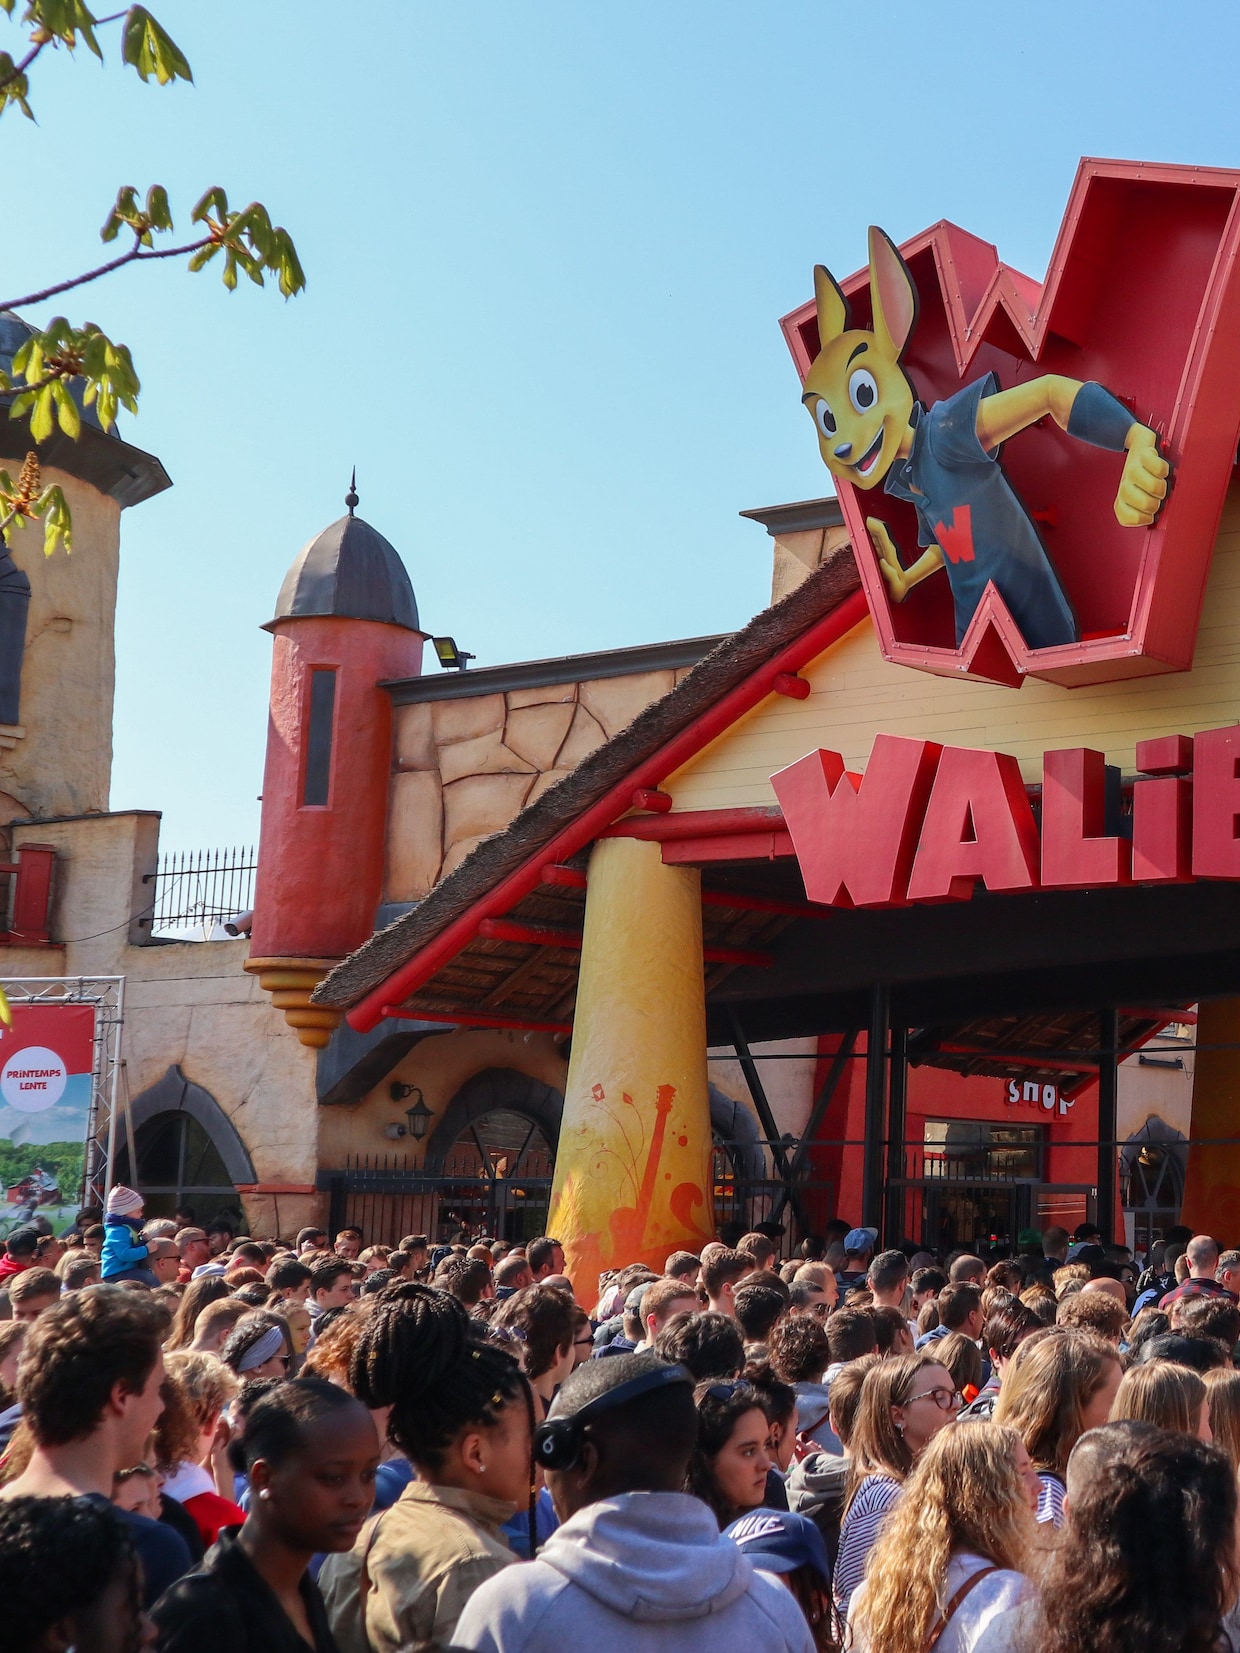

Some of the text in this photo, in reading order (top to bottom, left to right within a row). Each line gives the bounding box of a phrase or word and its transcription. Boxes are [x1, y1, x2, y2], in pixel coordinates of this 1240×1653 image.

[934, 504, 976, 565] W
[19, 1082, 48, 1091] LENTE
[727, 1516, 781, 1540] NIKE
